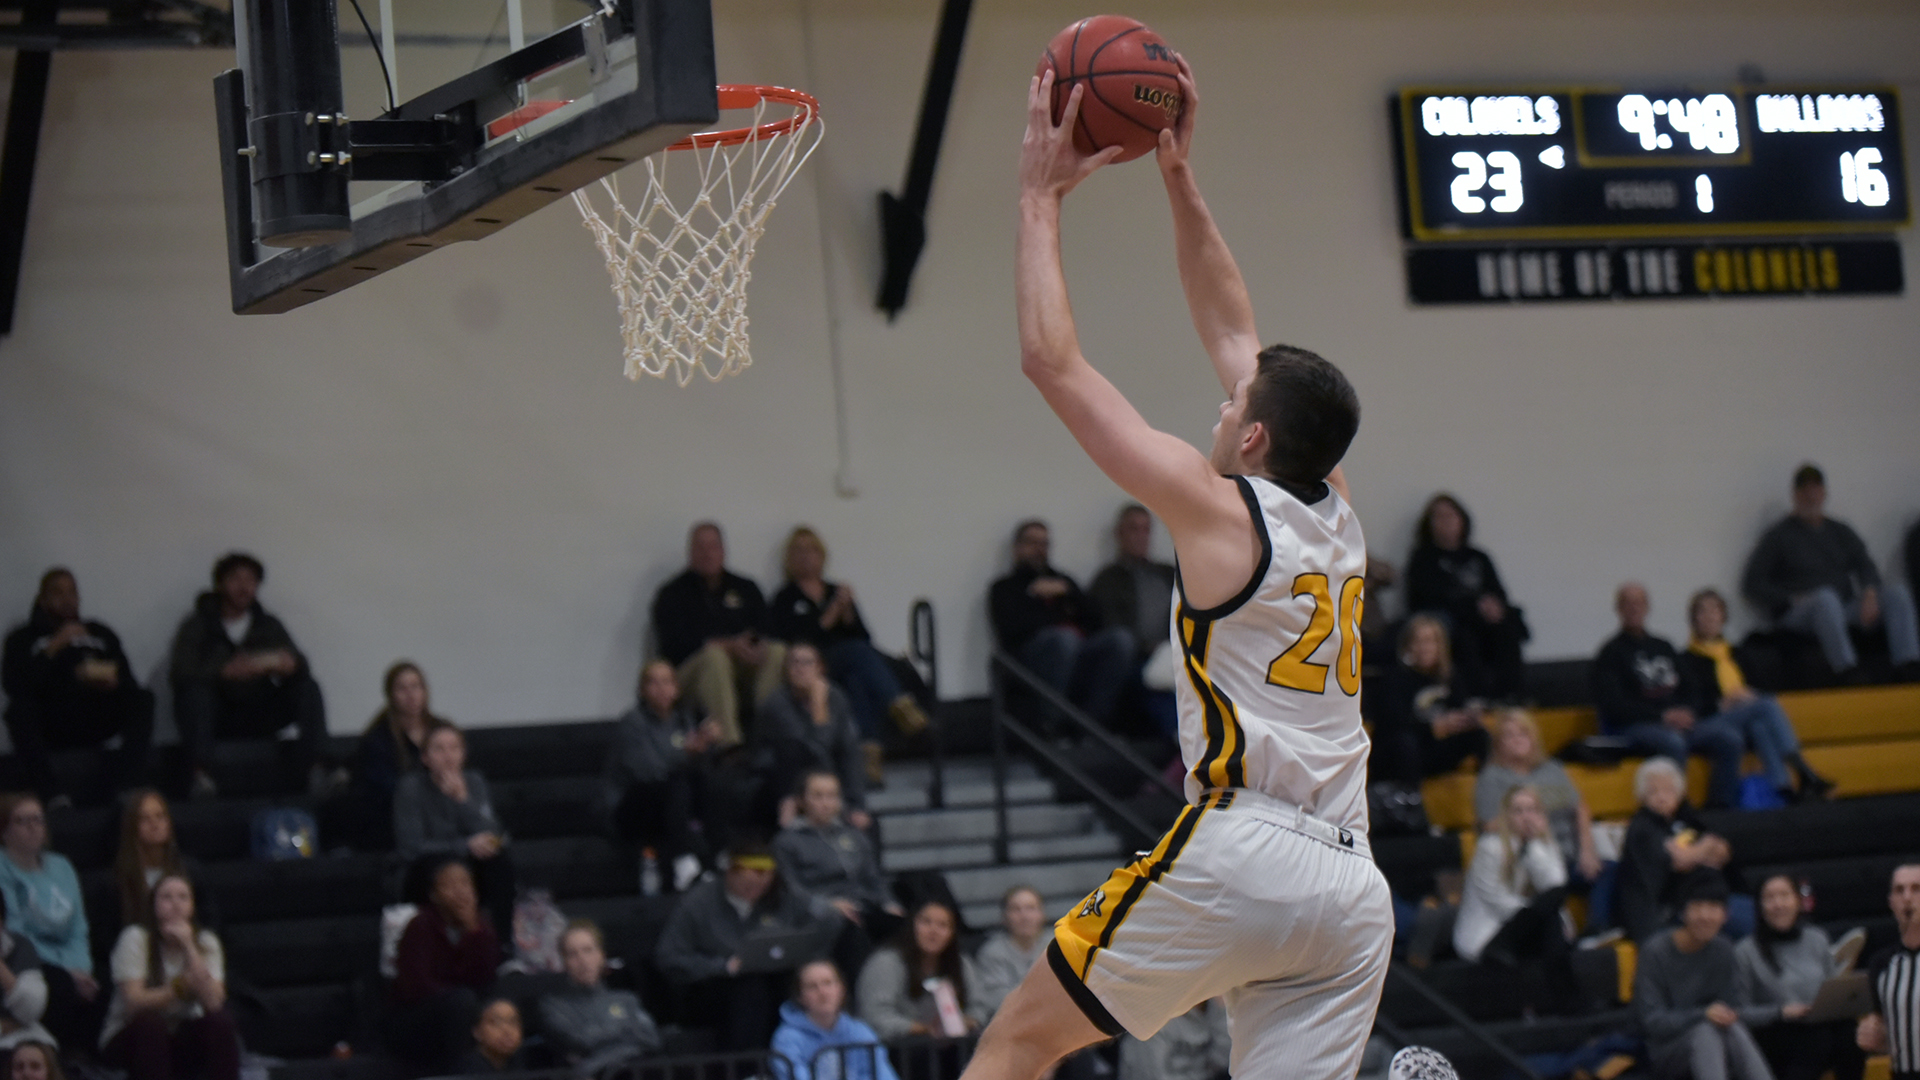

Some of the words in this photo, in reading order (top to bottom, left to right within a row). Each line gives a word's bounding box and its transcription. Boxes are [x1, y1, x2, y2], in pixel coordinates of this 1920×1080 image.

[1617, 93, 1740, 154] 9:48
[1450, 150, 1525, 213] 23
[1839, 147, 1891, 207] 16
[1476, 250, 1564, 298] HOME
[1574, 250, 1613, 297] OF
[1624, 247, 1681, 295] THE
[1693, 246, 1841, 293] COLONELS
